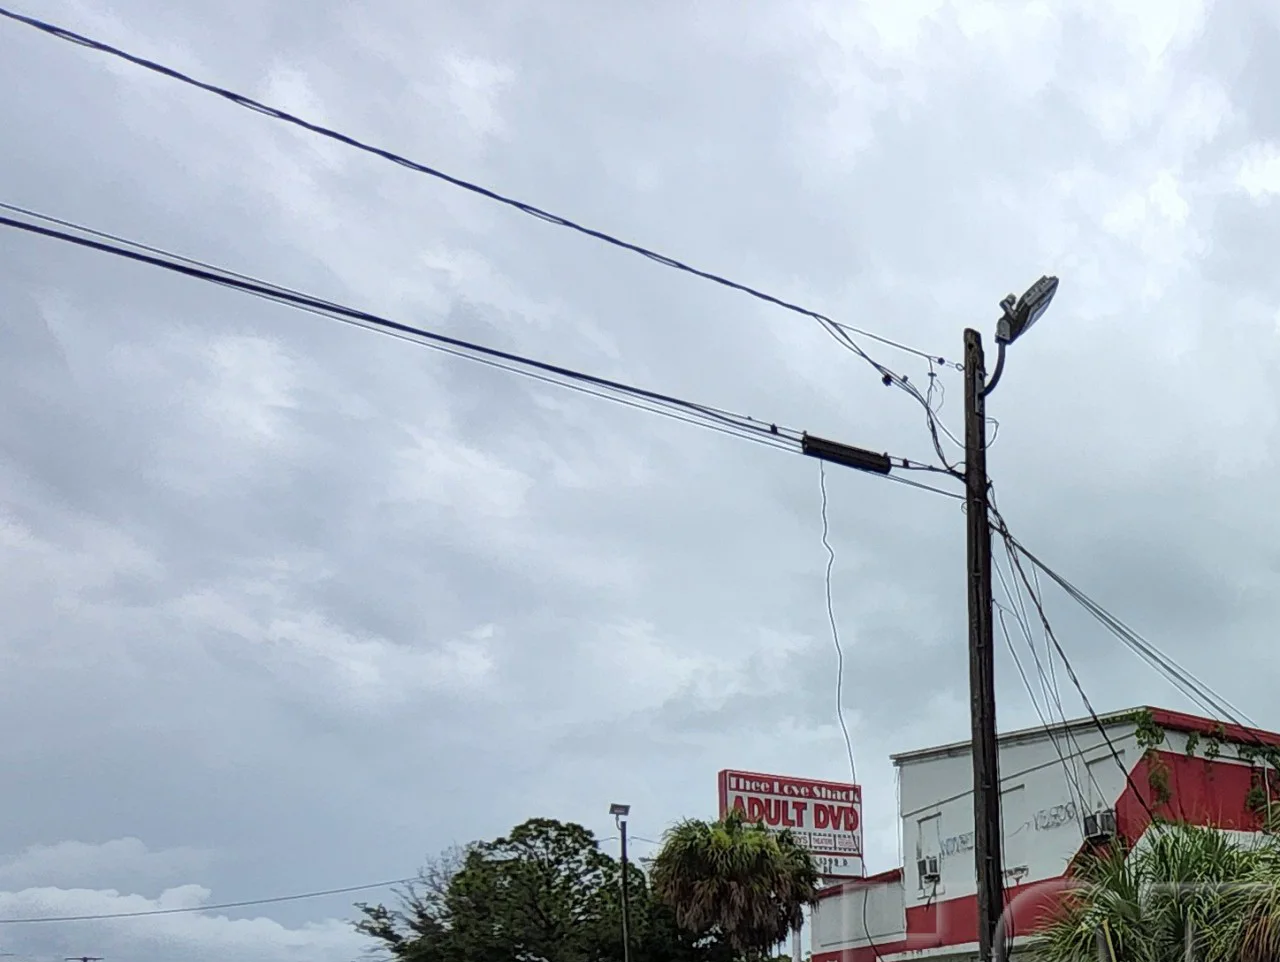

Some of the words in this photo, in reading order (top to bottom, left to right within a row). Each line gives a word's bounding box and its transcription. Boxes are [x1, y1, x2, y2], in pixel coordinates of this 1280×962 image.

[729, 776, 770, 792] Thee
[773, 781, 810, 798] Love
[812, 785, 860, 802] Shack
[732, 795, 808, 828] ADULT
[814, 803, 859, 832] DVD
